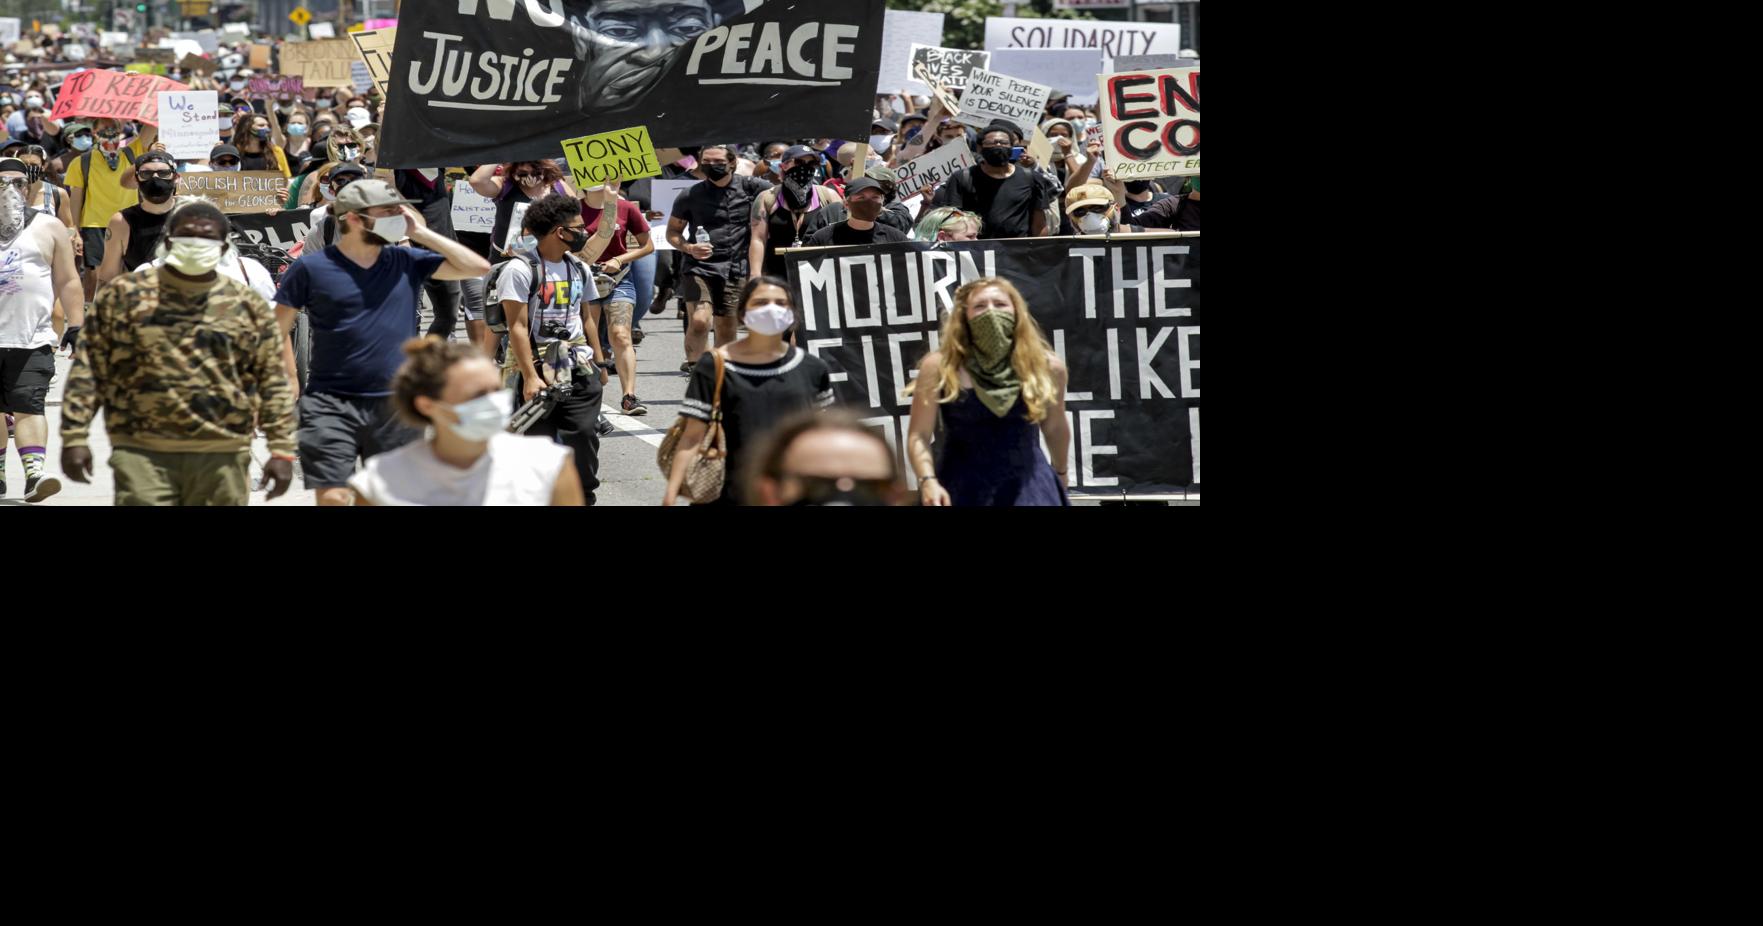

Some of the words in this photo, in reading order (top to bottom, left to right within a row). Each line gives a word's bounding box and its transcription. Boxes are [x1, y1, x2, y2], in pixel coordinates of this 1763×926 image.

[686, 22, 859, 79] PEACE
[927, 49, 972, 65] BLACK
[927, 62, 964, 77] IVES
[69, 71, 96, 95] TO
[973, 70, 1003, 87] WHITE
[169, 95, 194, 111] We
[970, 83, 993, 97] YOUR
[998, 91, 1041, 109] SILENCE
[55, 99, 73, 115] IS
[182, 111, 217, 123] Stand
[566, 131, 643, 162] TONY
[573, 153, 658, 186] MCDADE
[1115, 160, 1181, 174] PROTECT
[177, 175, 237, 191] ABOLISH
[243, 176, 284, 191] POLICE
[896, 166, 941, 200] KILLING
[238, 195, 278, 208] GEORGE
[1069, 246, 1192, 319] THE
[1053, 326, 1200, 400] LIKE
